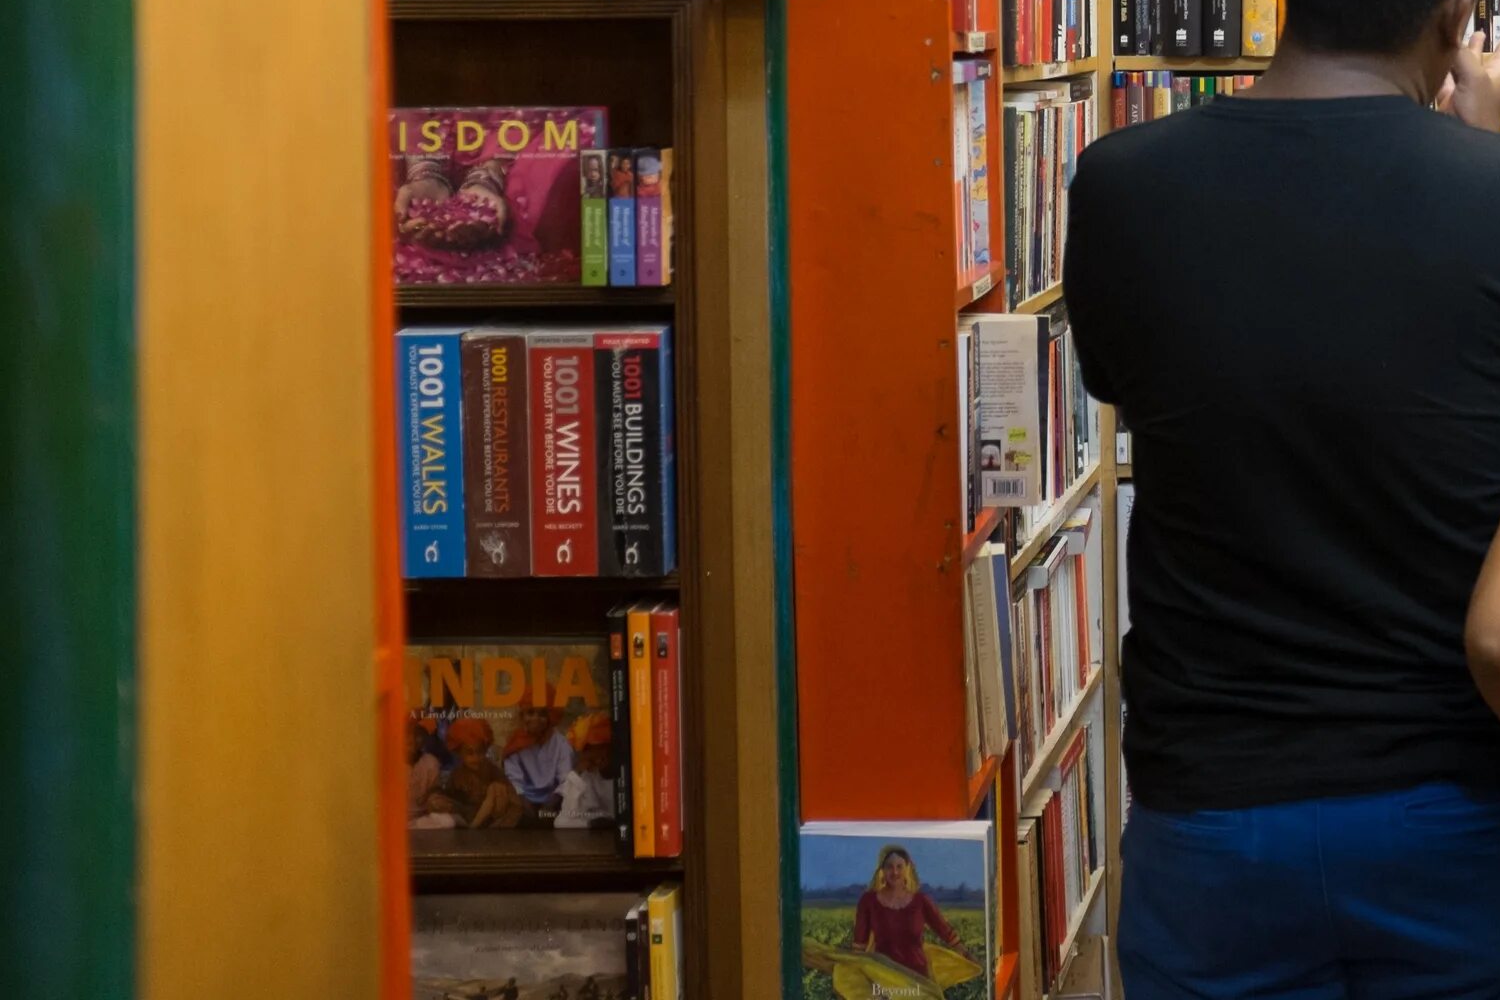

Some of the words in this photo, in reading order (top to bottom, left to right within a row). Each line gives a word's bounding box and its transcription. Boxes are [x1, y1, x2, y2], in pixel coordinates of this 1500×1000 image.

[409, 344, 419, 365] YOU
[482, 348, 491, 367] YOU
[491, 347, 507, 383] 1001
[543, 356, 553, 379] YOU
[409, 366, 419, 392] MUST
[418, 344, 445, 409] 1001
[482, 368, 491, 392] MUST
[611, 357, 622, 379] YOU
[623, 355, 642, 399] 1001
[543, 380, 554, 410] MUST
[555, 356, 579, 415] 1001
[612, 380, 623, 410] MUST
[409, 392, 420, 442] EXPERIENCE
[483, 393, 492, 443] EXPERIENCE
[543, 412, 554, 431] TRY
[612, 412, 623, 431] SEE
[410, 443, 421, 477] BEFORE
[483, 444, 492, 477] BEFORE
[491, 386, 510, 515] RESTAURANTS
[543, 433, 554, 471] BEFORE
[613, 433, 624, 471] BEFORE
[624, 403, 645, 515] BUILDINGS
[420, 414, 448, 515] WALKS
[555, 421, 582, 515] WINES
[412, 478, 421, 499] YOU
[484, 478, 493, 498] YOU
[544, 473, 555, 496] YOU
[613, 473, 625, 496] YOU
[412, 500, 422, 515] DIE
[484, 498, 494, 513] DIE
[545, 498, 555, 515] DIE
[615, 497, 625, 515] DIE
[406, 655, 599, 708] INDIA
[409, 711, 417, 719] A
[419, 710, 446, 719] Land
[447, 710, 462, 720] of
[463, 709, 513, 719] Contrasts
[872, 983, 921, 1000] Beyond
